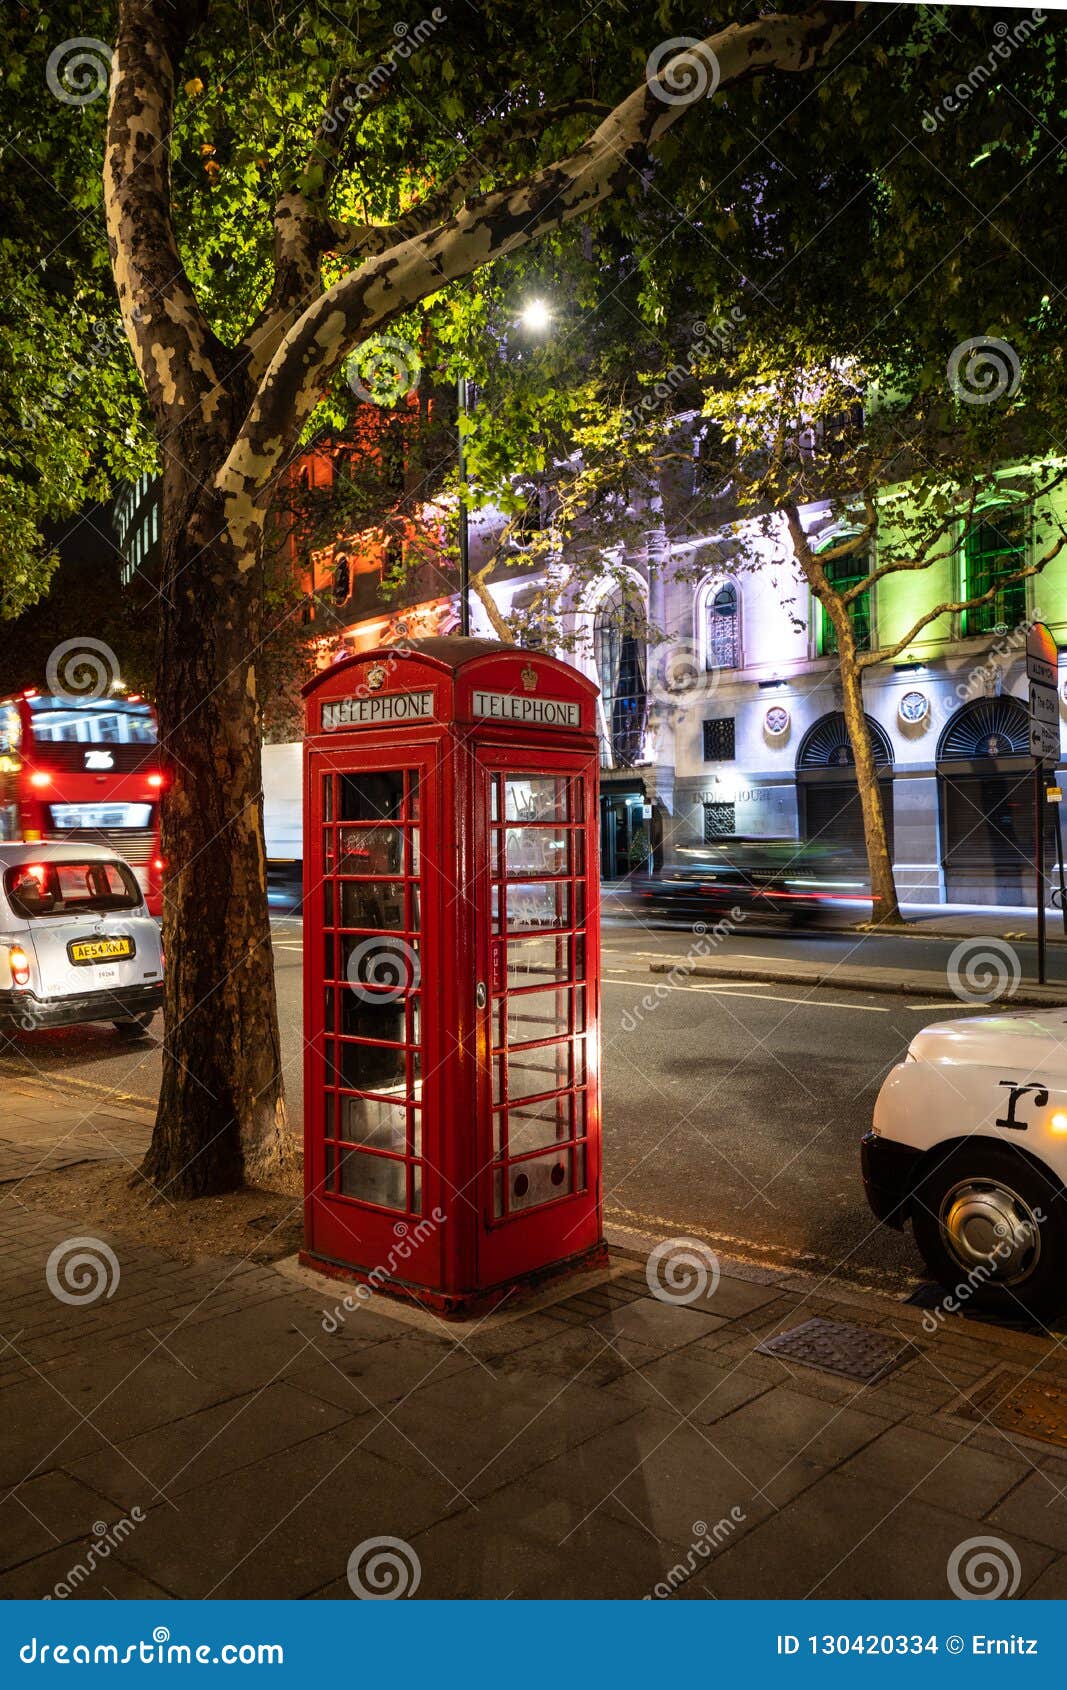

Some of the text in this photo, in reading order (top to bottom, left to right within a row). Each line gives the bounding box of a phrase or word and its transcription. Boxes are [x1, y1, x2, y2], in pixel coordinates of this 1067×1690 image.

[327, 694, 431, 723] TELEPHONE
[476, 694, 576, 725] TELEPHONE
[78, 942, 125, 957] AE54 KKA
[996, 1080, 1049, 1131] r
